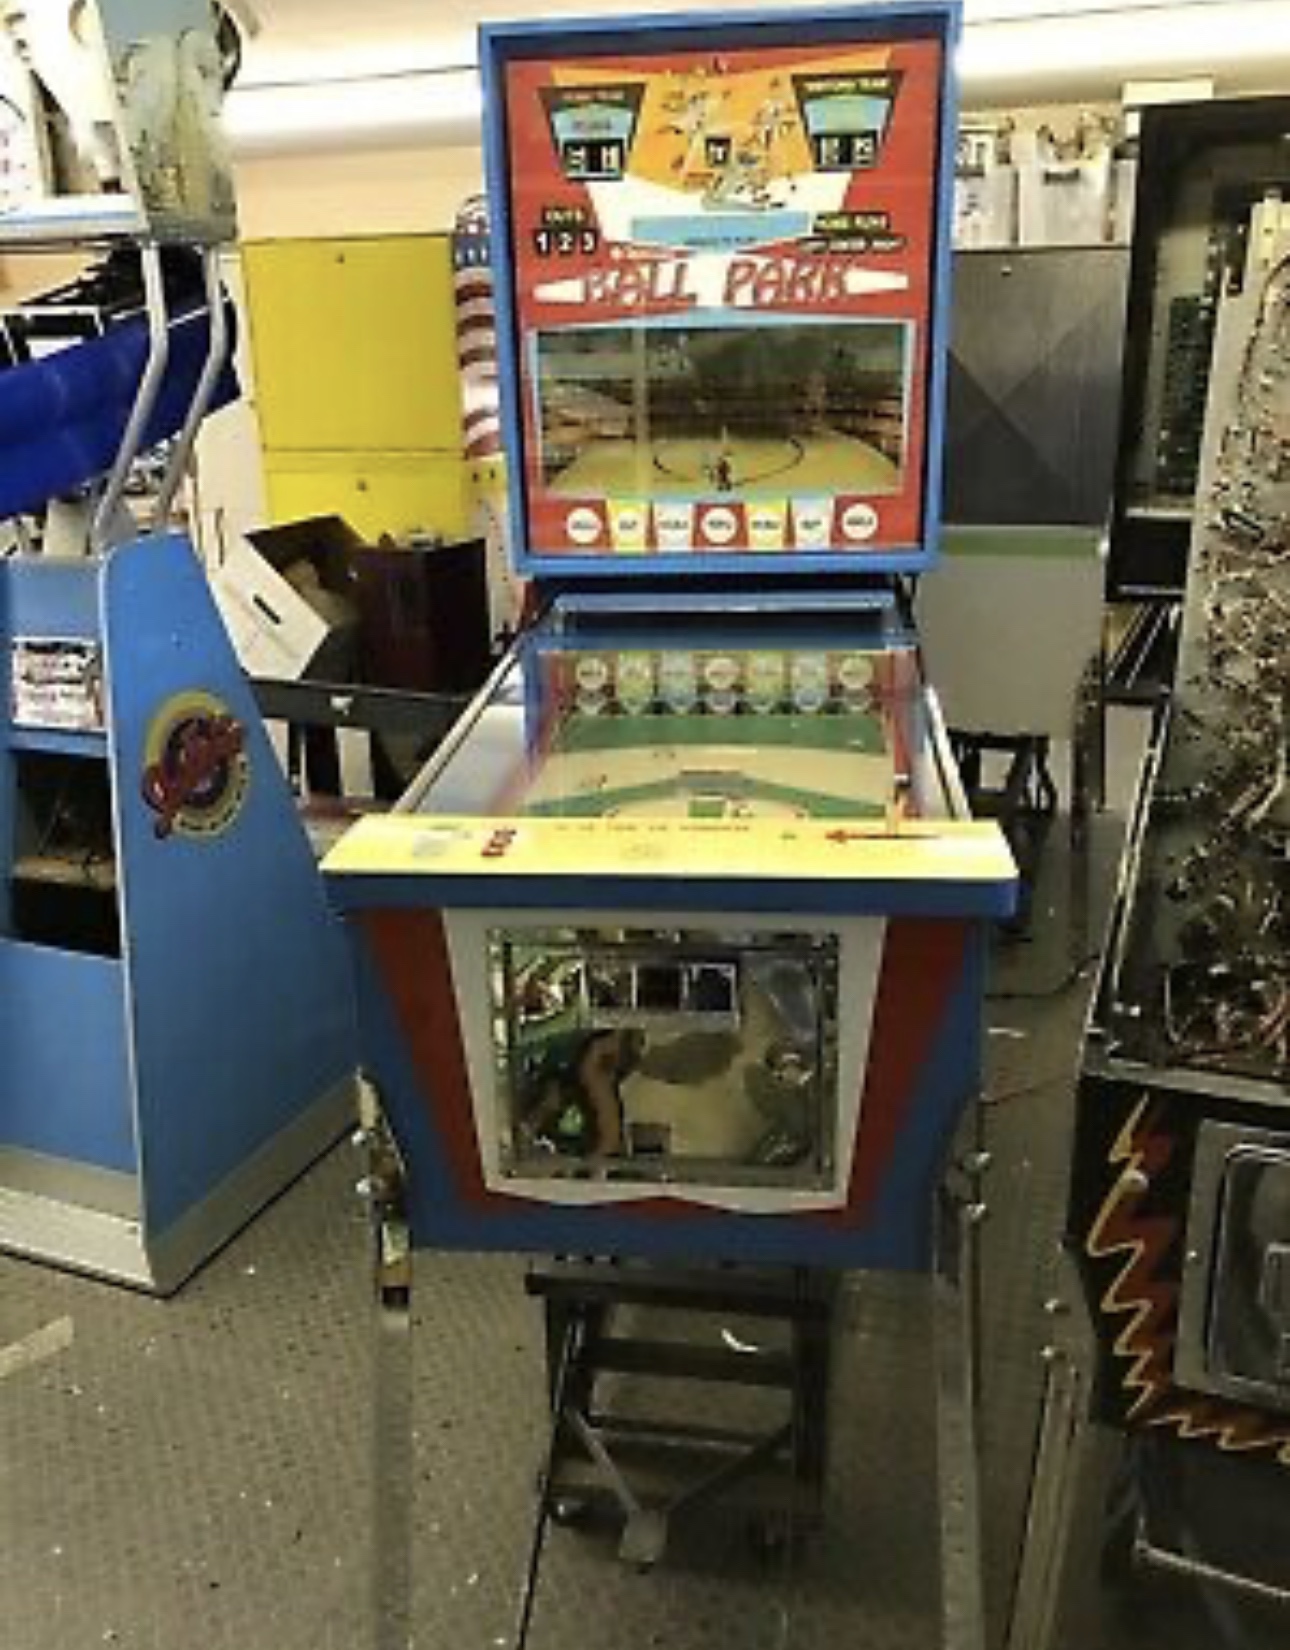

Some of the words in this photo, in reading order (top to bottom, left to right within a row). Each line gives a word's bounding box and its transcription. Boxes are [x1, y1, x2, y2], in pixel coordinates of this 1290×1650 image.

[536, 231, 549, 252] 1
[559, 231, 573, 251] 2
[583, 231, 595, 251] 3
[582, 259, 698, 308] BALL
[722, 254, 848, 307] PARK
